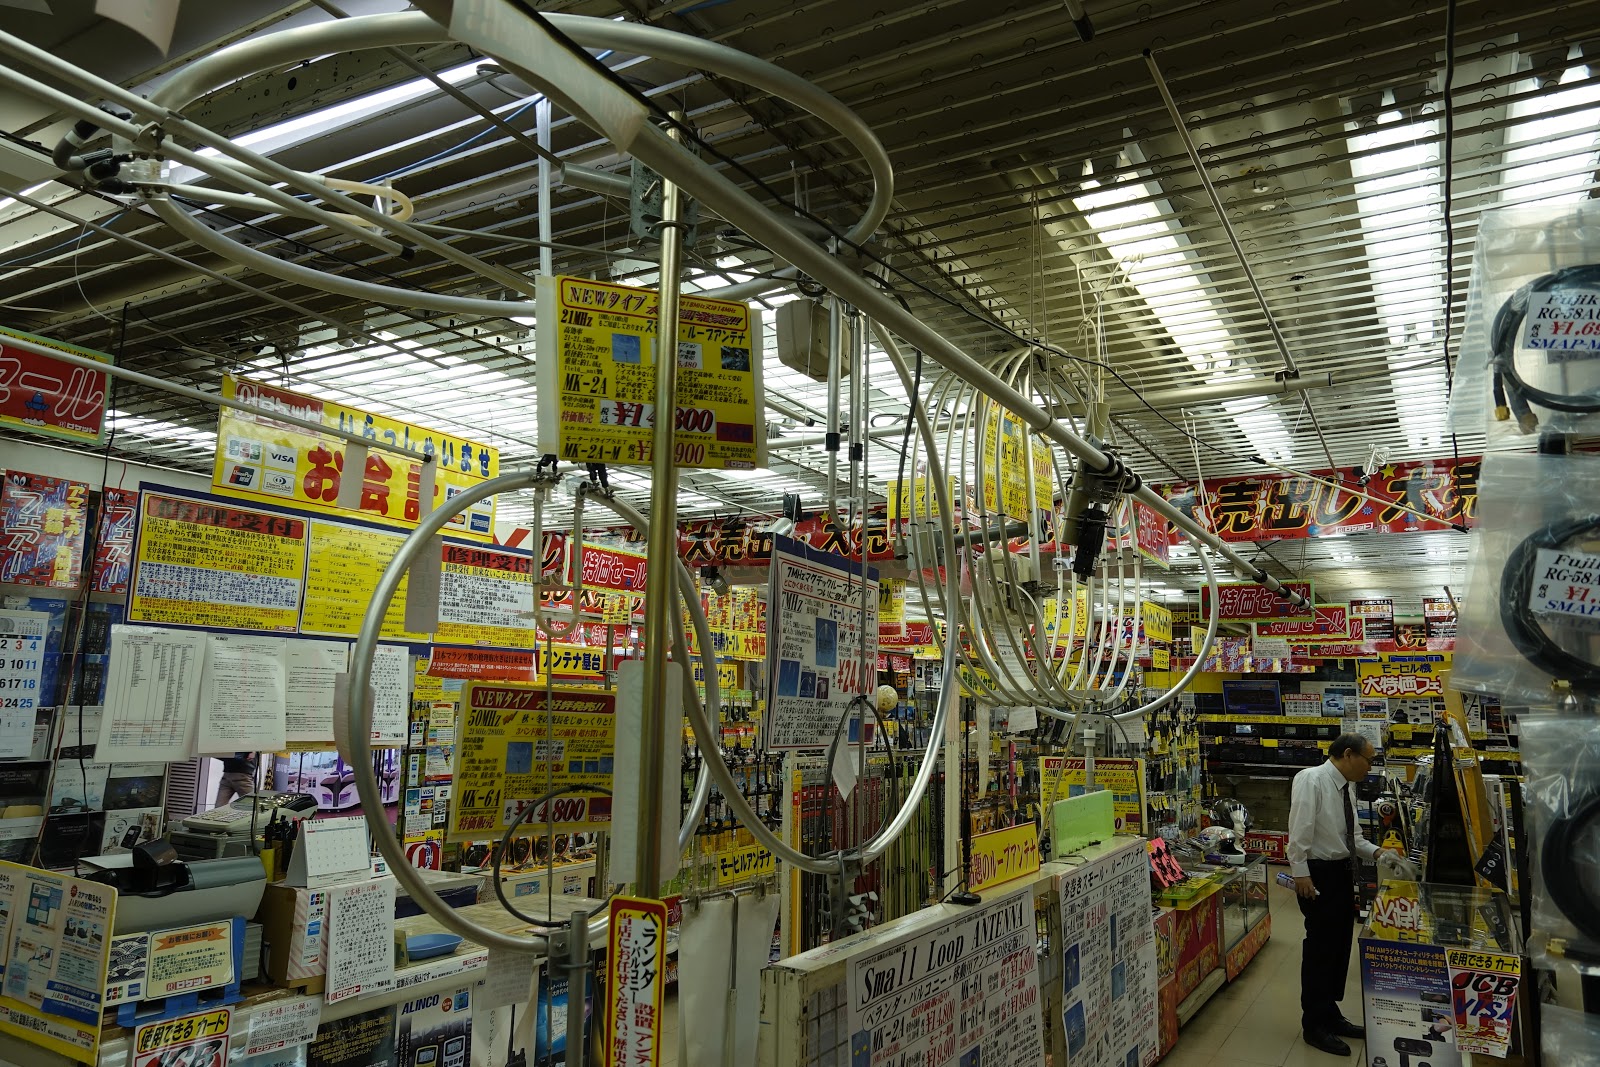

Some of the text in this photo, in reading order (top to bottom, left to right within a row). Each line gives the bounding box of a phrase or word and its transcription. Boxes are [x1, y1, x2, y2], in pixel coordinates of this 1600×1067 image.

[568, 286, 647, 311] NEWタイプ
[561, 309, 593, 327] 21MHz
[563, 373, 608, 395] MK-2A
[562, 410, 594, 425] 特価販売
[612, 401, 714, 432] ¥1800
[66, 421, 97, 434] ロケット
[270, 452, 295, 464] VISA
[562, 443, 622, 461] MK-2A-M
[477, 499, 492, 507] ISA
[448, 546, 532, 573] 修理受付
[583, 551, 646, 589] 特価セール
[782, 591, 803, 613] 7MHz
[15, 640, 23, 650] 3
[29, 641, 37, 651] 4
[10, 659, 37, 670] 10 11
[543, 650, 601, 671] アンテナ基台
[1382, 663, 1432, 674] モービル機
[8, 678, 36, 689] 17 18
[5, 698, 33, 709] 24 25
[475, 690, 533, 709] NEWタイプ
[468, 710, 502, 727] 50MHz
[460, 789, 501, 808] MK-6A
[514, 797, 586, 824] ¥14800
[458, 815, 496, 831] 特価販売
[720, 850, 772, 877] モービルアンテナ
[169, 930, 216, 944] お客様にお願い
[641, 911, 658, 989] ベランダ
[861, 945, 918, 1005] Small
[926, 934, 964, 973] Loop
[971, 901, 1024, 951] ANTENNA
[1449, 951, 1520, 971] 使用できる カード
[177, 975, 212, 989] ロケット
[613, 912, 632, 1067] 当店にお任せください。歴史
[1451, 971, 1518, 996] JCB
[402, 994, 439, 1015] ALINCO
[1453, 998, 1512, 1021] VISA
[140, 1019, 194, 1051] 使用できる
[196, 1013, 227, 1036] カード
[634, 1002, 655, 1067] 設置アンテ
